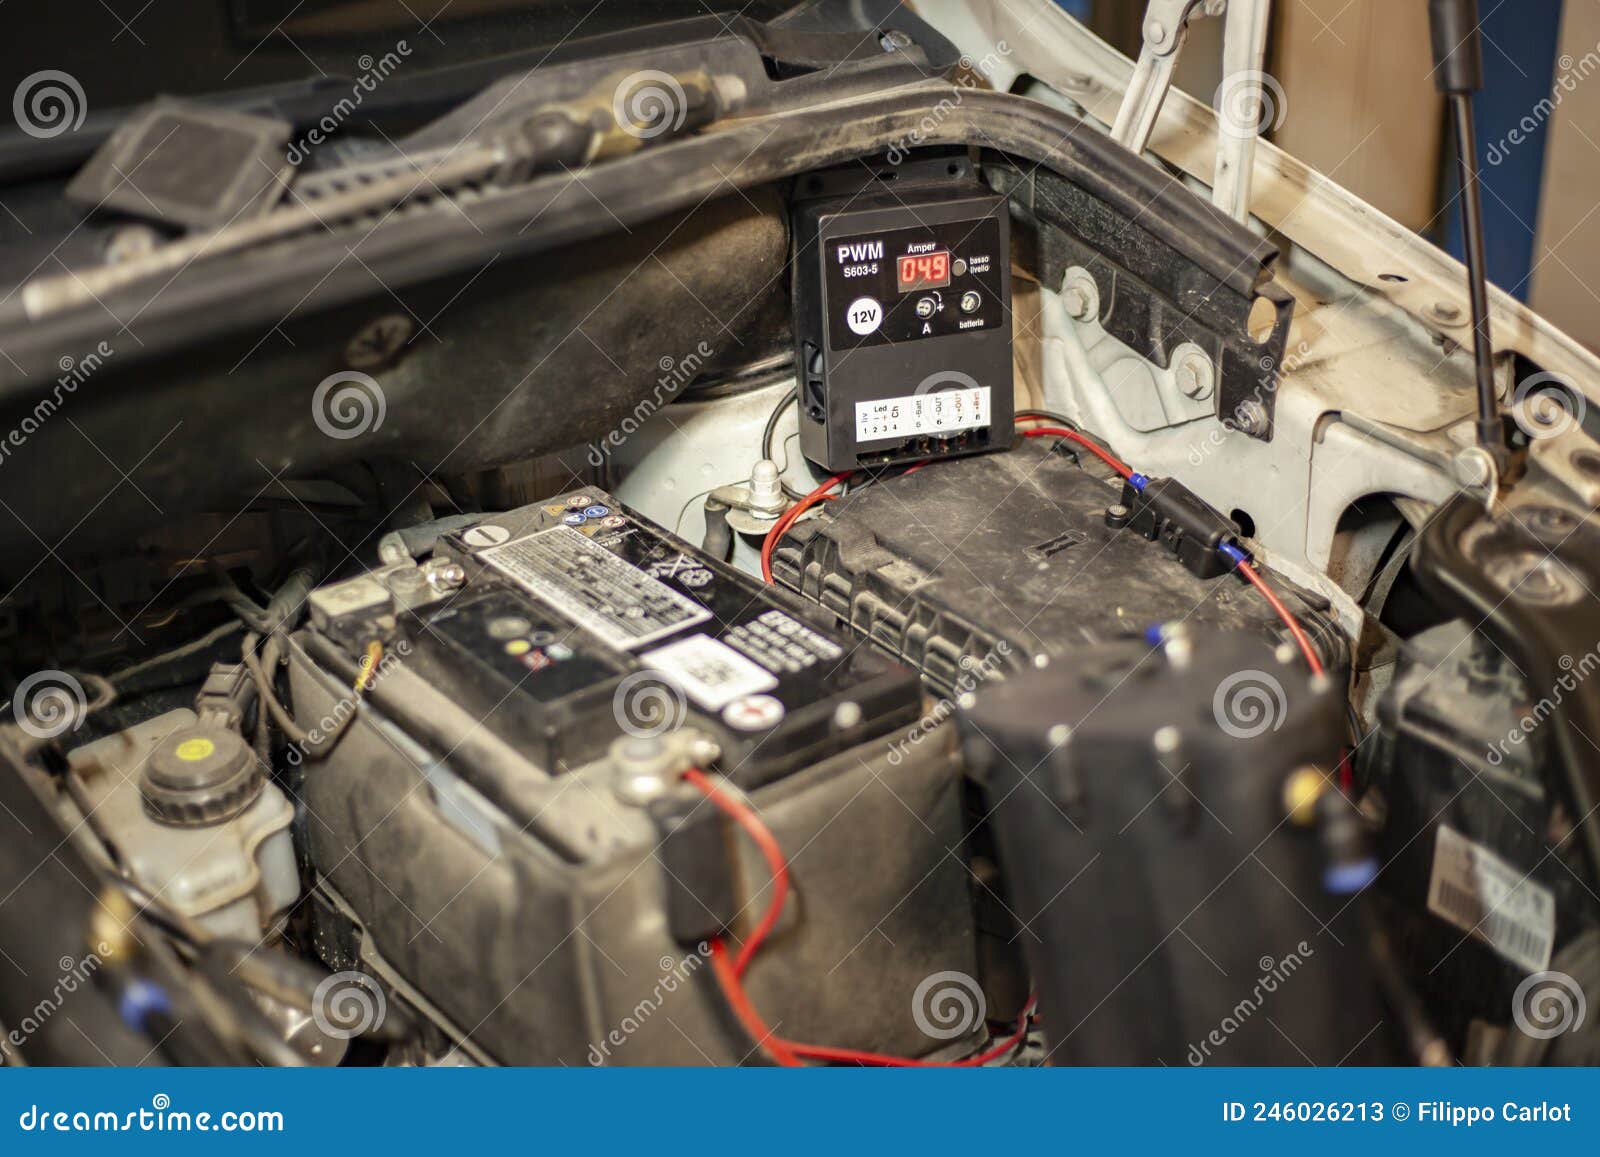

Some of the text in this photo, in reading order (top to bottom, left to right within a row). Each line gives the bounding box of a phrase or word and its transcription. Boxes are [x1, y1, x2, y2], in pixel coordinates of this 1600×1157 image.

[838, 242, 884, 264] PWM
[907, 243, 937, 254] Amper
[844, 264, 878, 278] S603-5
[853, 309, 877, 324] 12V
[922, 322, 932, 335] A
[959, 319, 985, 329] batteria
[873, 405, 888, 413] Led
[891, 405, 899, 418] Ch
